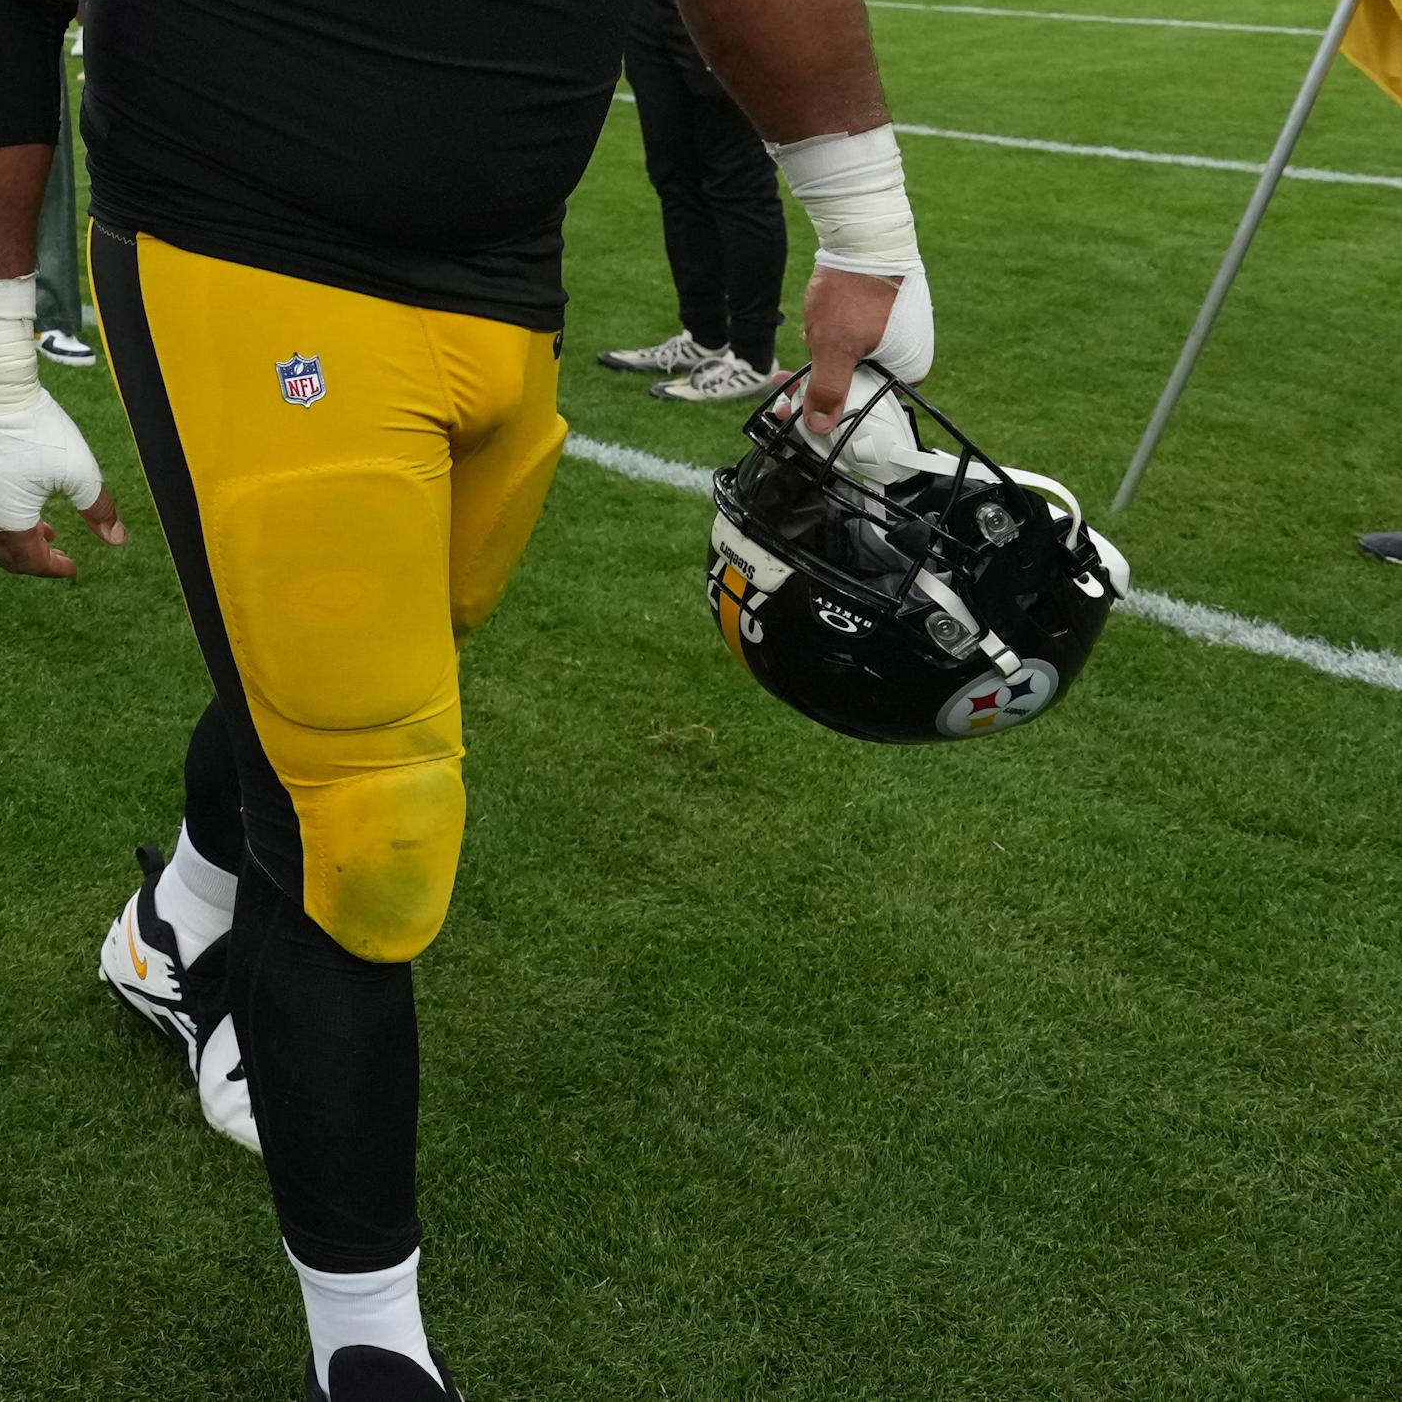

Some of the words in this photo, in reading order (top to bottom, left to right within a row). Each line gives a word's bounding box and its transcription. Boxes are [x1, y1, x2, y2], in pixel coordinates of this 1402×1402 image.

[287, 376, 320, 398] NFL
[719, 540, 756, 581] Steelers
[814, 596, 873, 629] OAKLEY
